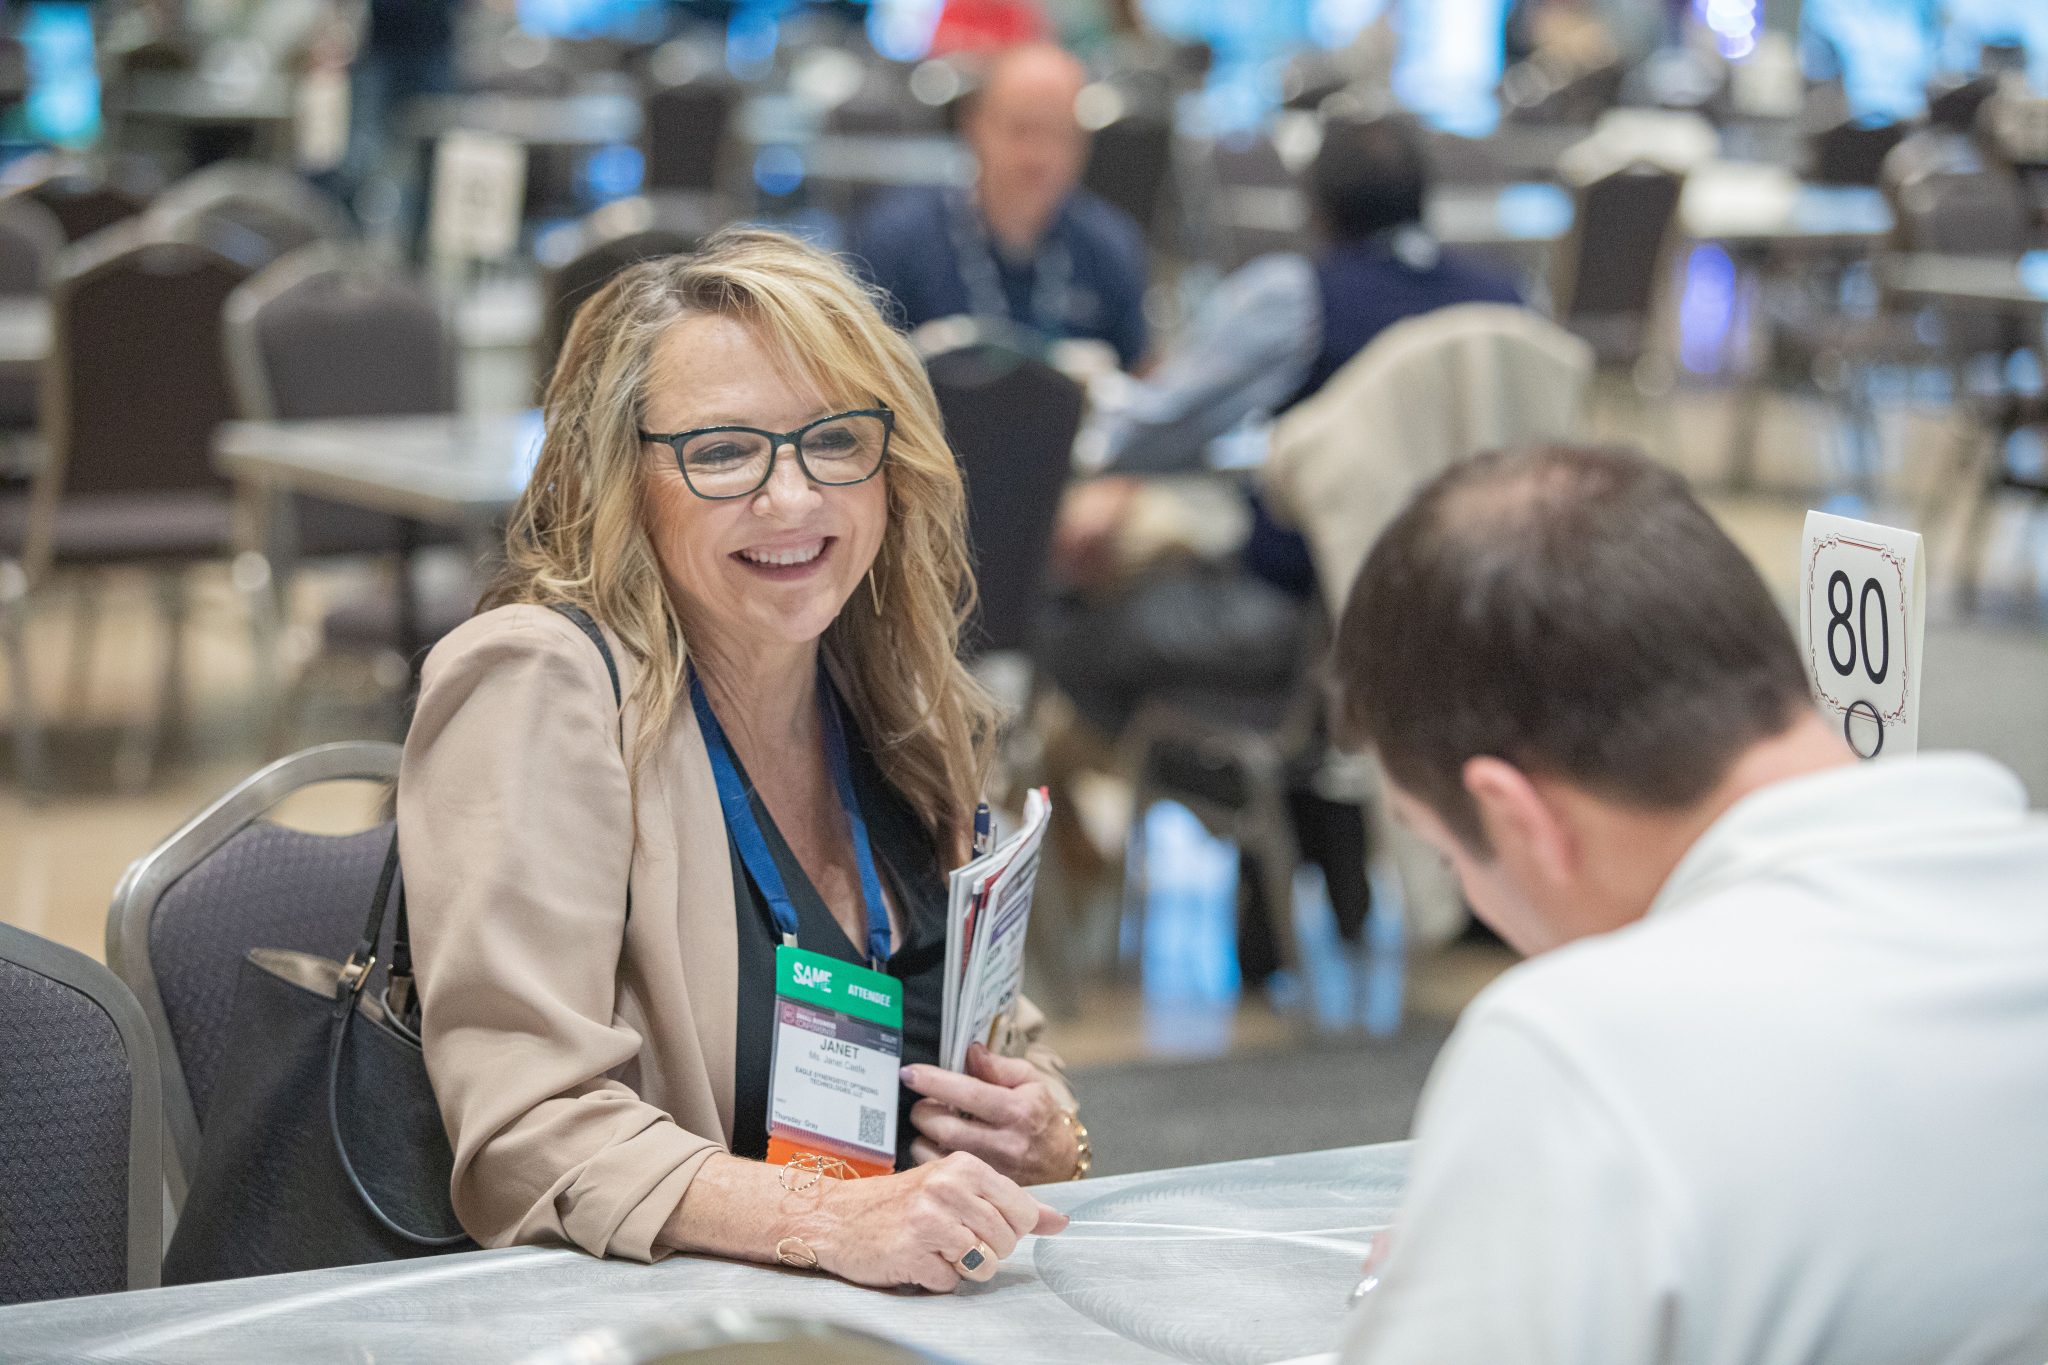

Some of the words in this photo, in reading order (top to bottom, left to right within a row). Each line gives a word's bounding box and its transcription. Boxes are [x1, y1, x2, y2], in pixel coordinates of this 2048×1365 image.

[1827, 569, 1889, 684] 80
[793, 961, 832, 993] SAME
[848, 984, 891, 1007] ATTENDEE
[820, 1039, 860, 1059] JANET
[795, 1066, 812, 1076] EAGLE
[824, 1057, 843, 1068] Janet
